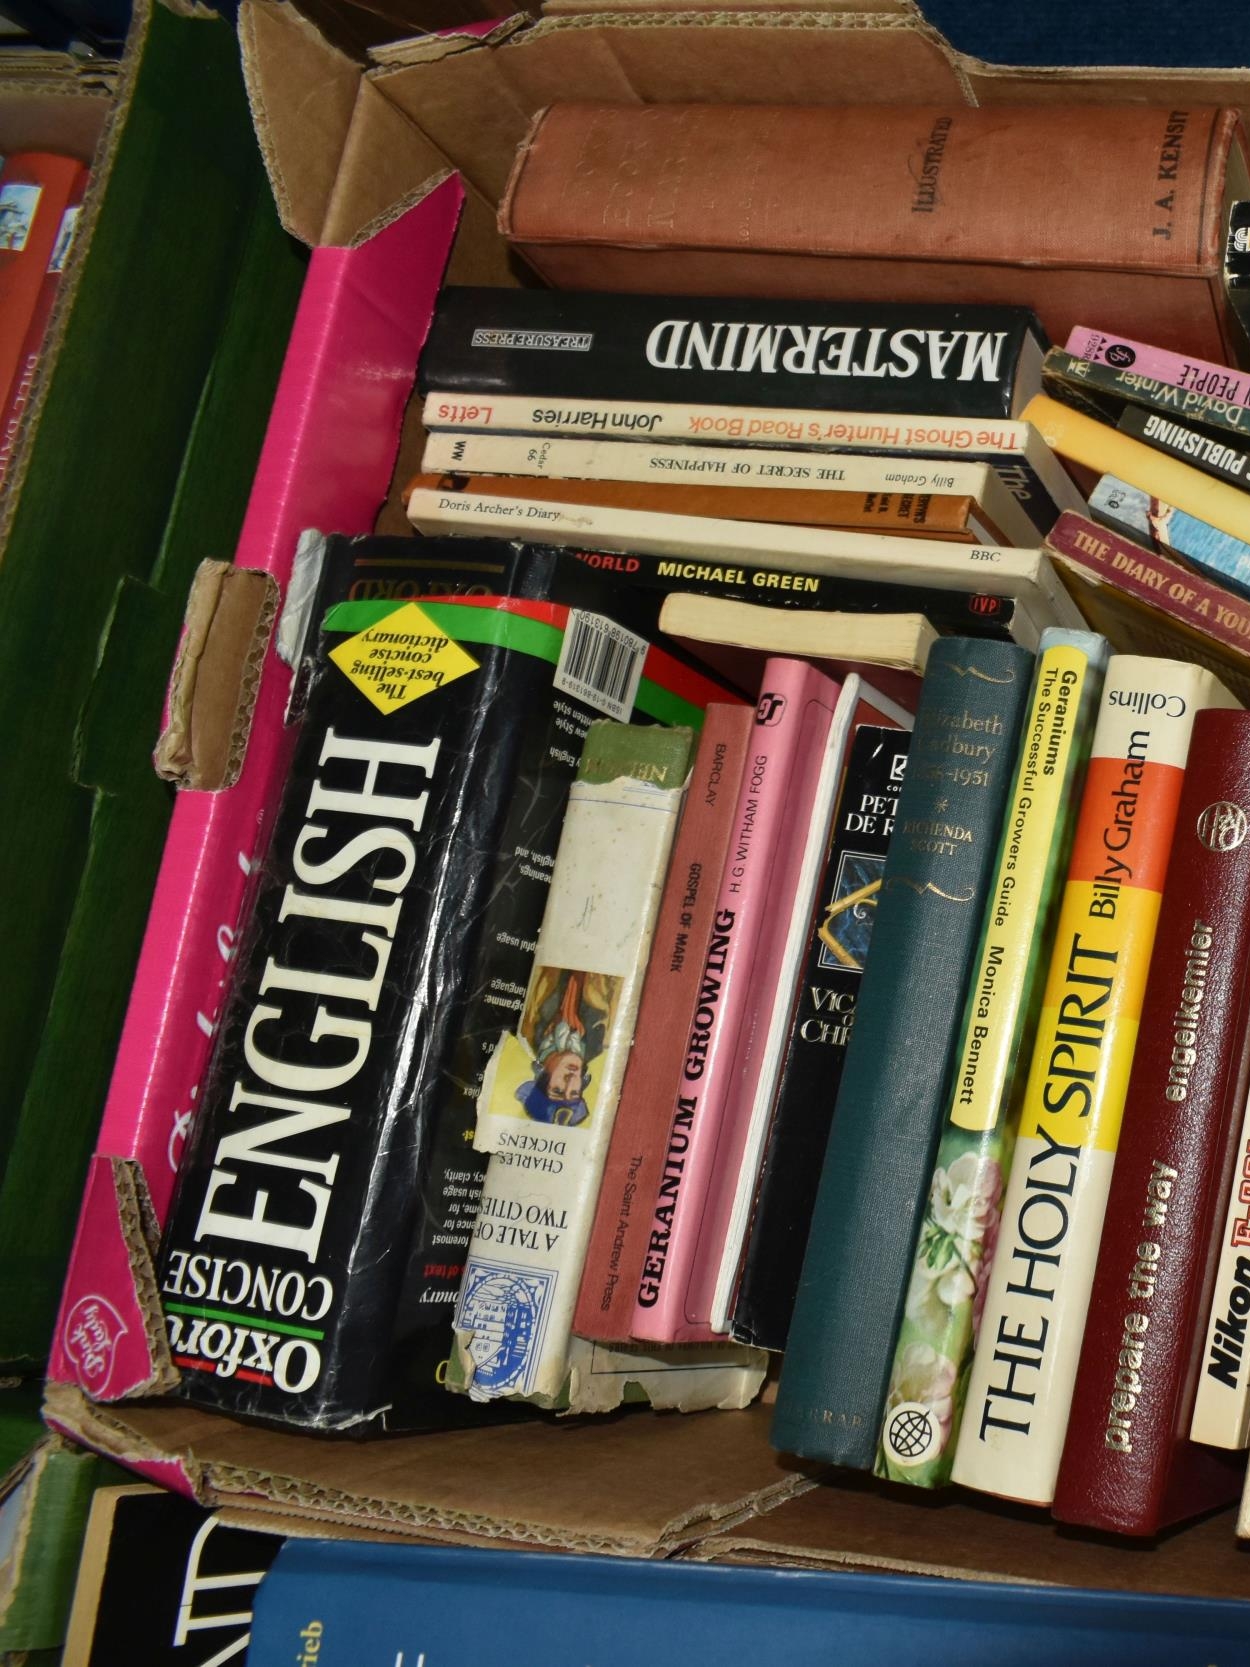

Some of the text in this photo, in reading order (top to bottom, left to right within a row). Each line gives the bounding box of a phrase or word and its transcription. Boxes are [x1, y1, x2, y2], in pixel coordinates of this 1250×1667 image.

[911, 116, 953, 213] ILLUSTRATED
[646, 319, 1008, 382] MASTERMIND
[1115, 370, 1244, 425] David Winter
[1176, 364, 1241, 400] PEOPLE
[437, 403, 493, 424] Letts
[531, 408, 662, 431] John Harries
[649, 457, 846, 481] THE SECRET OF HAPPINESS
[1143, 413, 1249, 475] PUBLISHING
[437, 498, 561, 521] Doris Archer's Diary
[657, 561, 820, 593] MICHAEL GREEN
[970, 550, 1001, 562] BBC
[361, 628, 449, 651] dictionary
[368, 647, 433, 663] concise
[1042, 669, 1078, 777] Geraniums
[1108, 689, 1187, 718] Collins
[704, 743, 727, 807] BARCLAY
[993, 667, 1059, 928] The Successful Growers Guide
[1089, 729, 1151, 921] Billy Graham
[193, 727, 443, 1264] ENGLISH
[1165, 918, 1216, 1103] engelkemier
[959, 944, 1005, 1105] Monica Bennett
[636, 907, 736, 1309] GERANIUM GROWING
[496, 1151, 564, 1174] CHARLES
[497, 1132, 567, 1156] DICKENS
[979, 932, 1119, 1444] THE HOLY SPIRIT
[499, 1225, 539, 1250] TALE
[545, 1232, 561, 1252] A
[600, 1155, 643, 1312] The Saint Andrew Press
[162, 1249, 334, 1321] CONCISE
[1104, 1159, 1179, 1454] prepare the way
[70, 1324, 106, 1379] Pink
